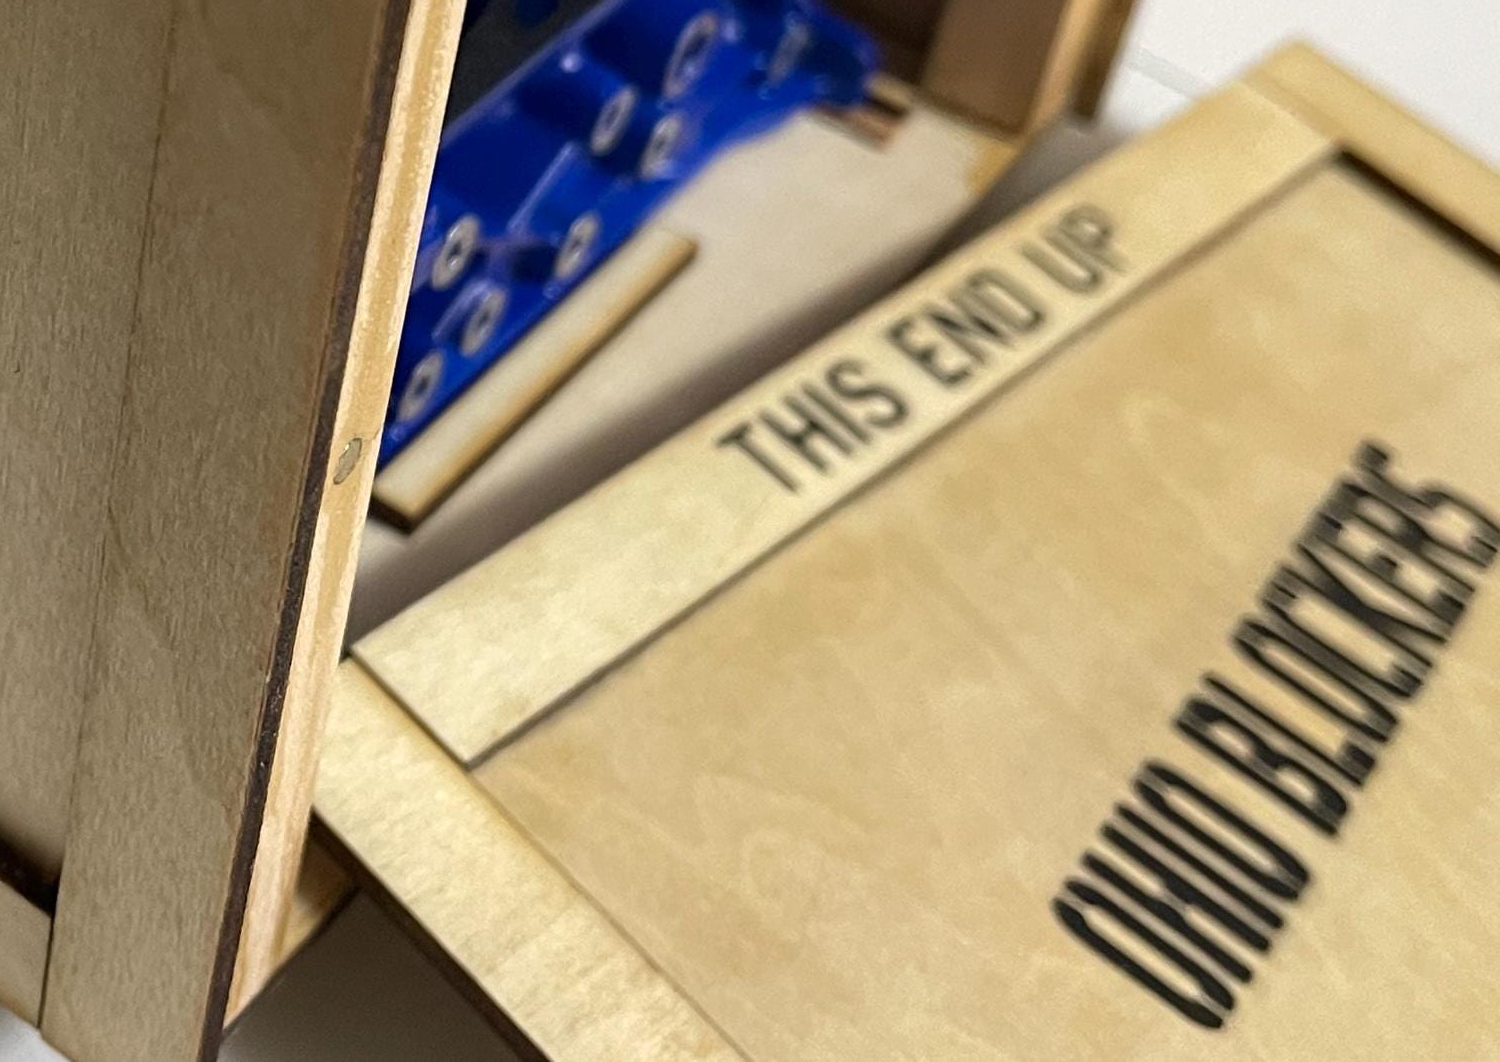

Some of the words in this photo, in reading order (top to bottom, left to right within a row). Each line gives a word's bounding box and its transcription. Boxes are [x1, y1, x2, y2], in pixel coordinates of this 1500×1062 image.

[713, 359, 909, 493] THIS
[886, 267, 1047, 388] END
[1018, 204, 1130, 295] UP
[1172, 437, 1500, 838] BLOCKERS
[1051, 758, 1312, 1029] OHIO
